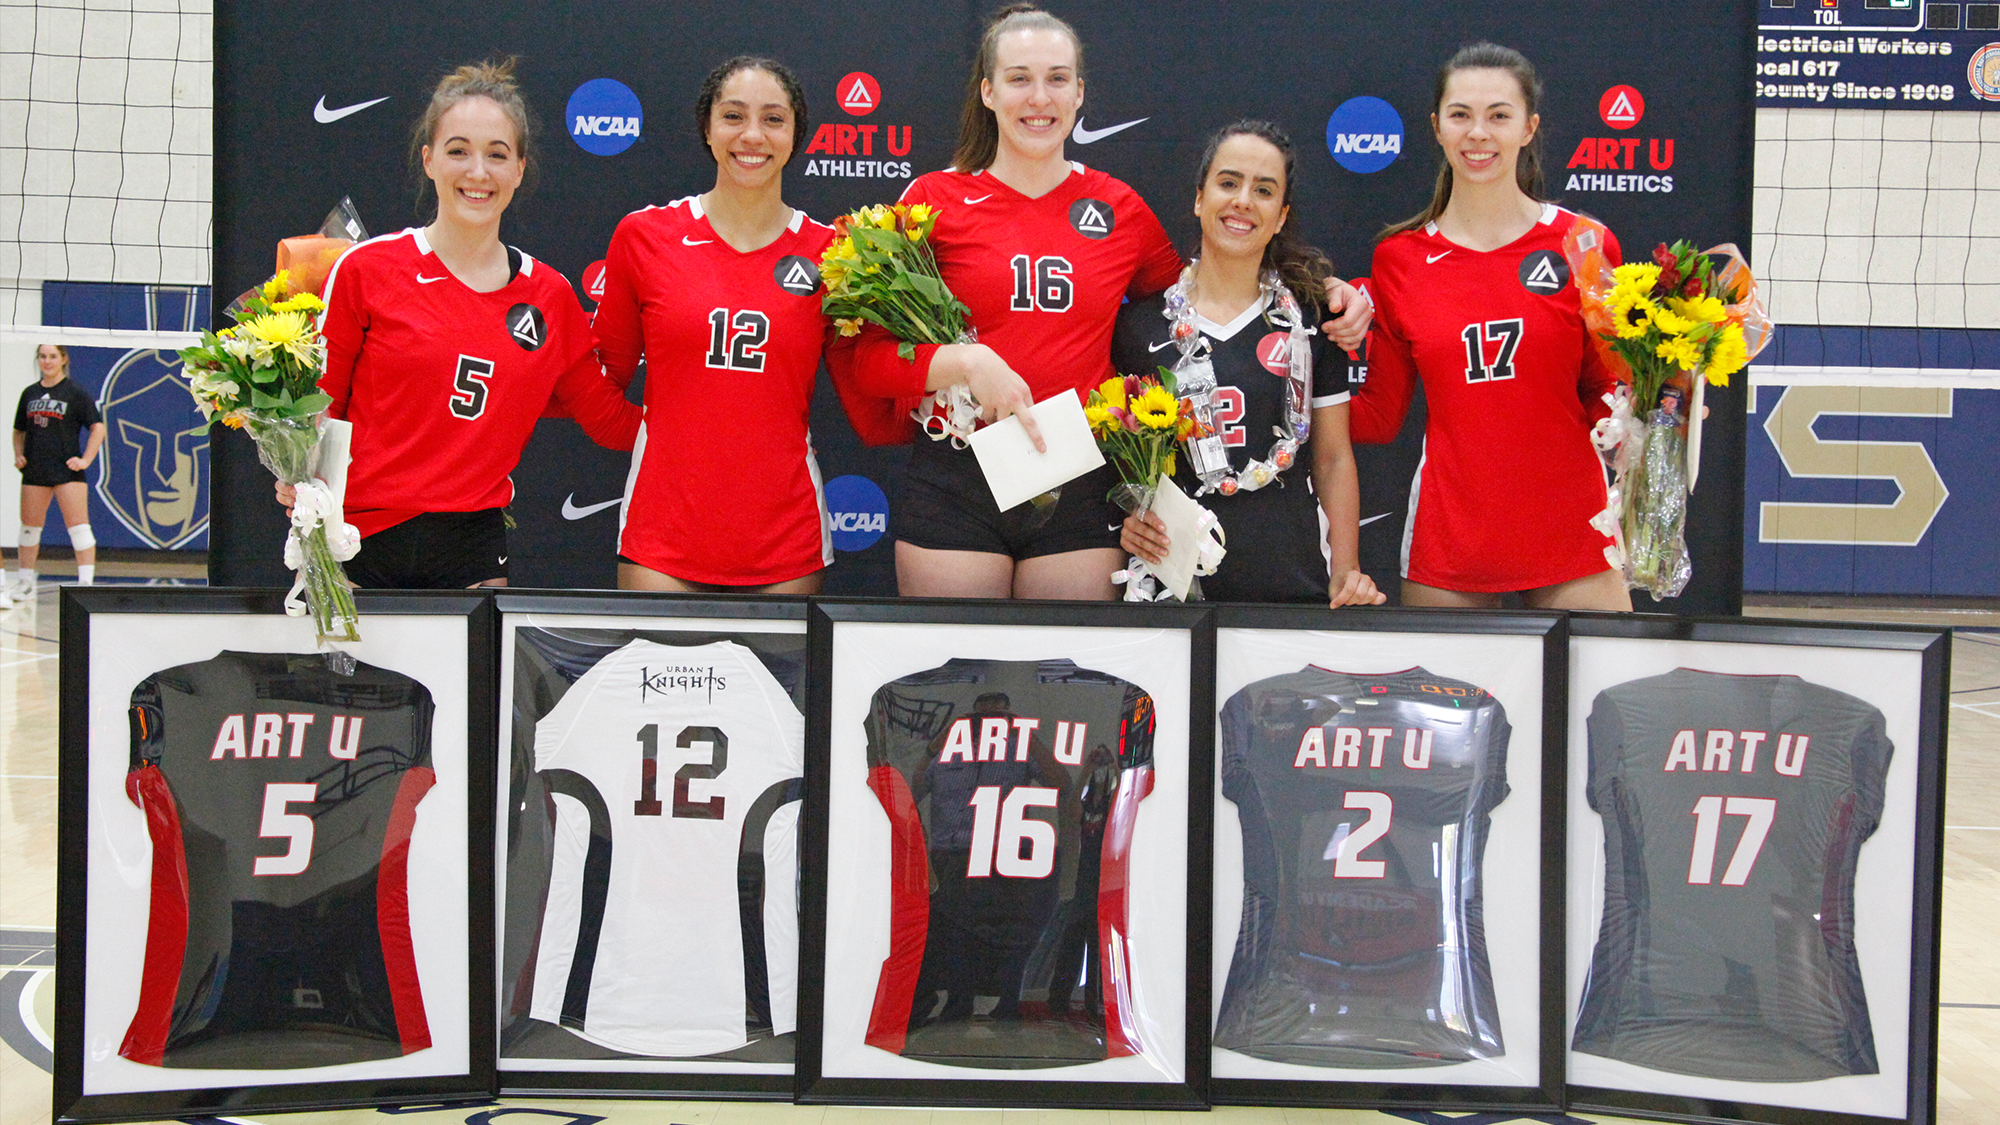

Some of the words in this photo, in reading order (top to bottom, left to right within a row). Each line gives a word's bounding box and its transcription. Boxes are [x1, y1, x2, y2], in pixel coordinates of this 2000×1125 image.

[1813, 10, 1842, 25] TOL
[1802, 60, 1841, 77] 617
[1857, 37, 1953, 55] Workers
[1832, 82, 1897, 100] Since
[1901, 83, 1955, 101] 1908
[574, 115, 640, 138] NCAA
[804, 123, 878, 156] ART
[887, 125, 912, 157] U
[1334, 132, 1400, 155] NCAA
[804, 159, 912, 179] ATHLETICS
[1565, 137, 1640, 170] ART
[1648, 138, 1675, 171] U
[1565, 173, 1674, 193] ATHLETICS
[1010, 254, 1074, 313] 16
[705, 307, 770, 373] 12
[1461, 317, 1524, 384] 17
[449, 353, 495, 421] 5
[1208, 386, 1247, 448] 2
[828, 512, 886, 533] NCAA
[666, 665, 704, 674] URBAN
[209, 712, 315, 761] ART
[328, 715, 364, 761] U
[938, 716, 1040, 765] ART
[1053, 720, 1088, 766] U
[1292, 726, 1394, 769] ART
[1402, 727, 1434, 770] U
[1663, 728, 1768, 773] ART
[1774, 732, 1811, 777] U
[634, 723, 729, 820] 12
[252, 782, 319, 877] 5
[965, 785, 1060, 879] 16
[1333, 790, 1395, 880] 2
[1687, 795, 1779, 887] 17
